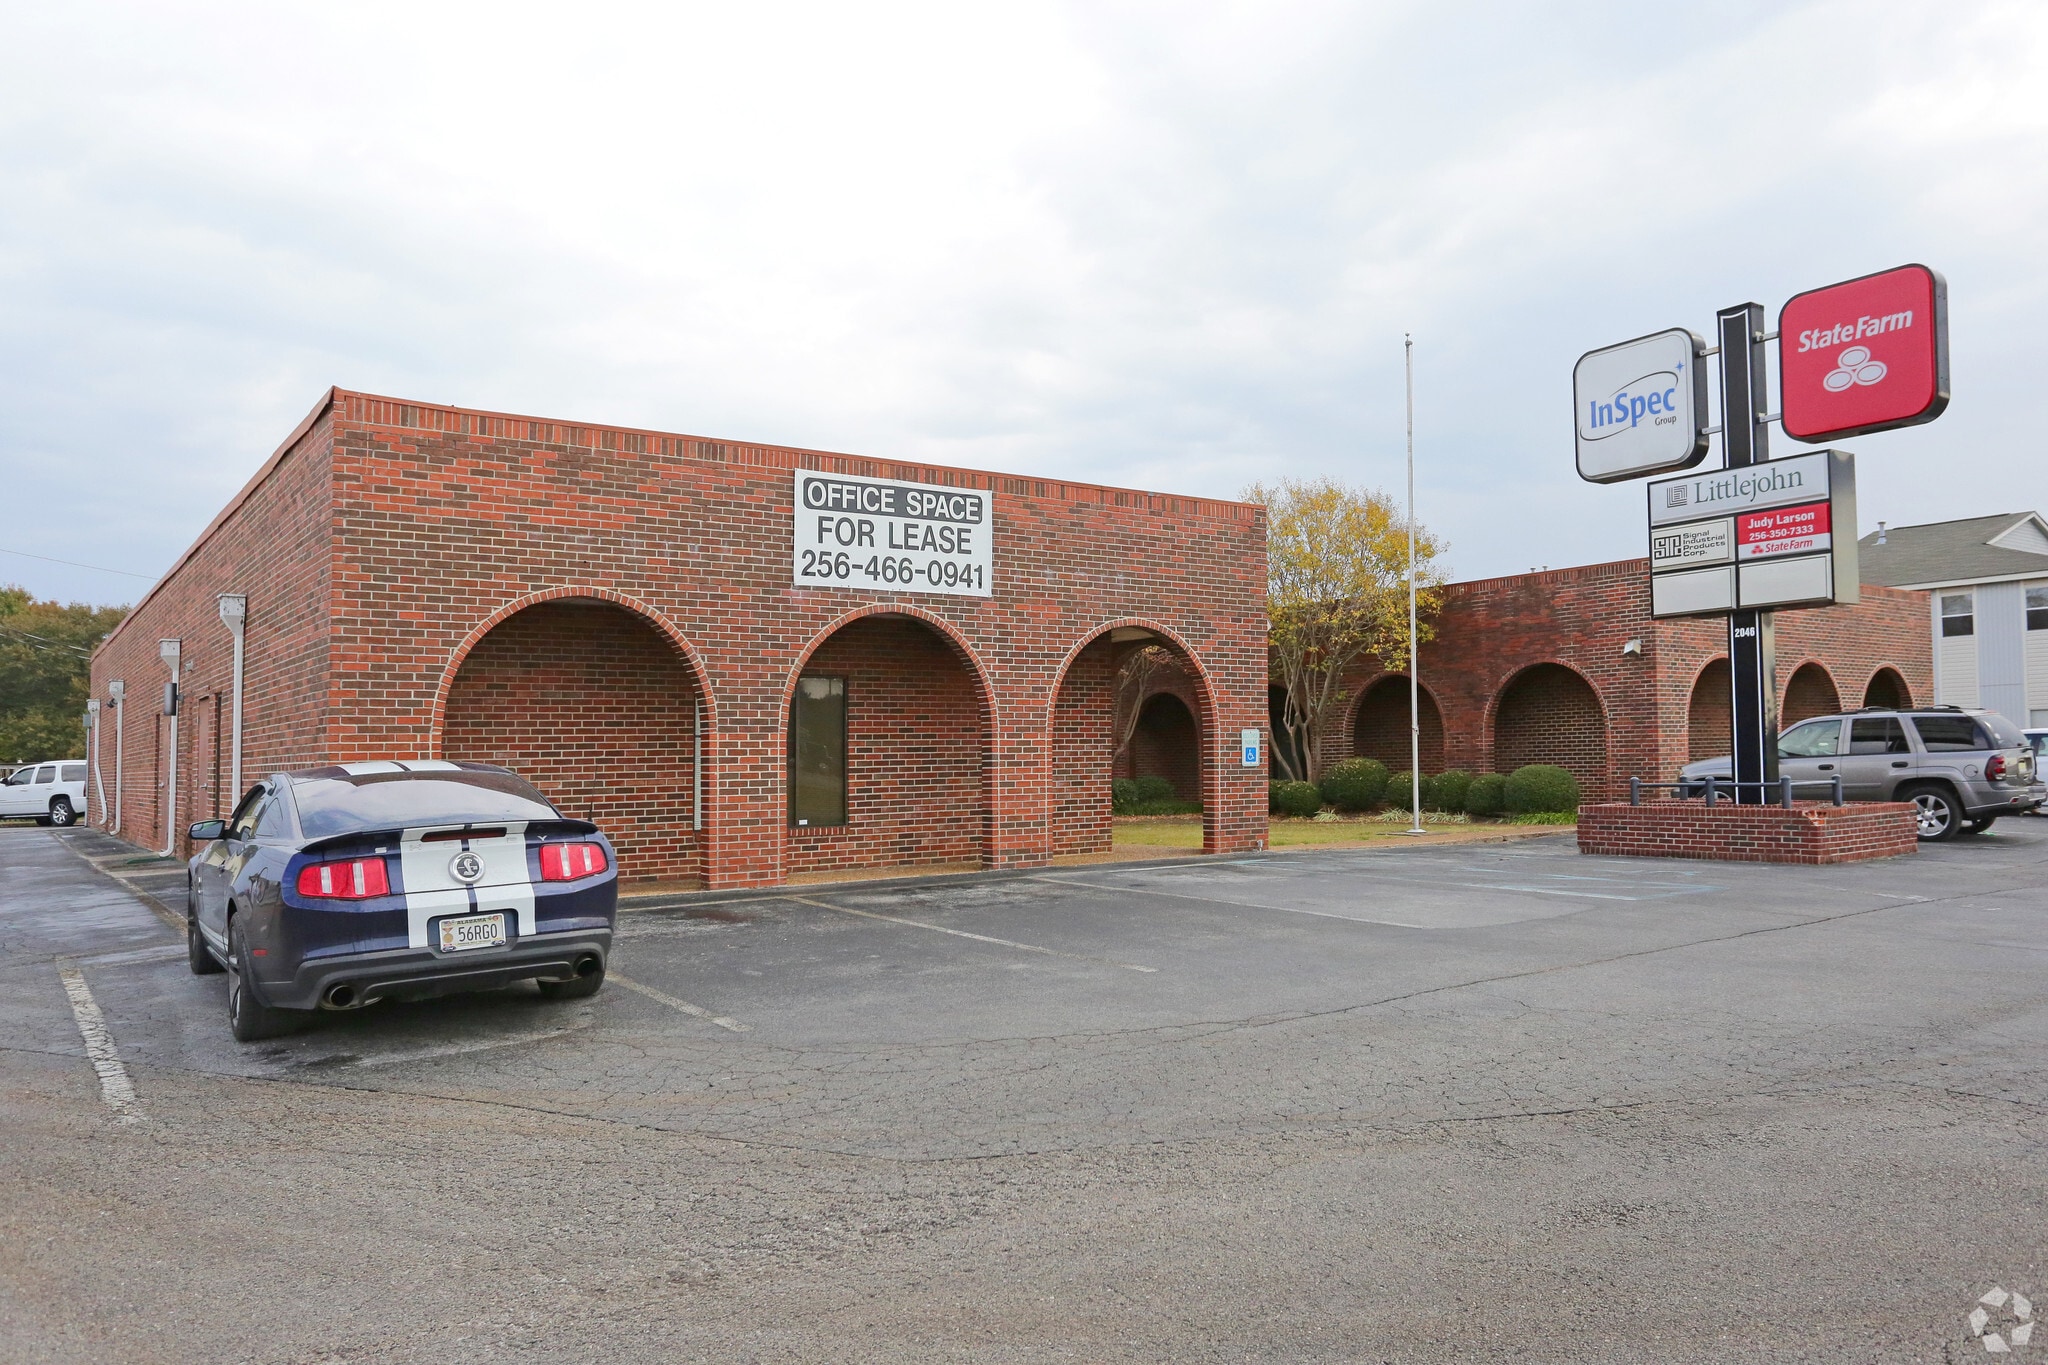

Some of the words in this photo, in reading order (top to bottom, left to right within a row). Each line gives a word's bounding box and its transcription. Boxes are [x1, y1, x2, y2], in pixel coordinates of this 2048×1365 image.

[1590, 387, 1675, 428] InSpec
[1654, 415, 1677, 427] Group
[1694, 468, 1803, 504] Littlejohn
[807, 481, 895, 513] OFFICE
[906, 491, 980, 521] SPACE
[1747, 516, 1773, 529] Judy
[1776, 511, 1815, 525] Larson
[817, 515, 875, 548] FOR
[888, 521, 972, 555] LEASE
[1682, 530, 1710, 539] Signal
[1683, 533, 1725, 545] Industrial
[1749, 524, 1814, 541] 256-350-7333
[1683, 541, 1726, 551] Products
[1683, 549, 1708, 557] Corp.
[801, 549, 983, 589] 256-466-0941
